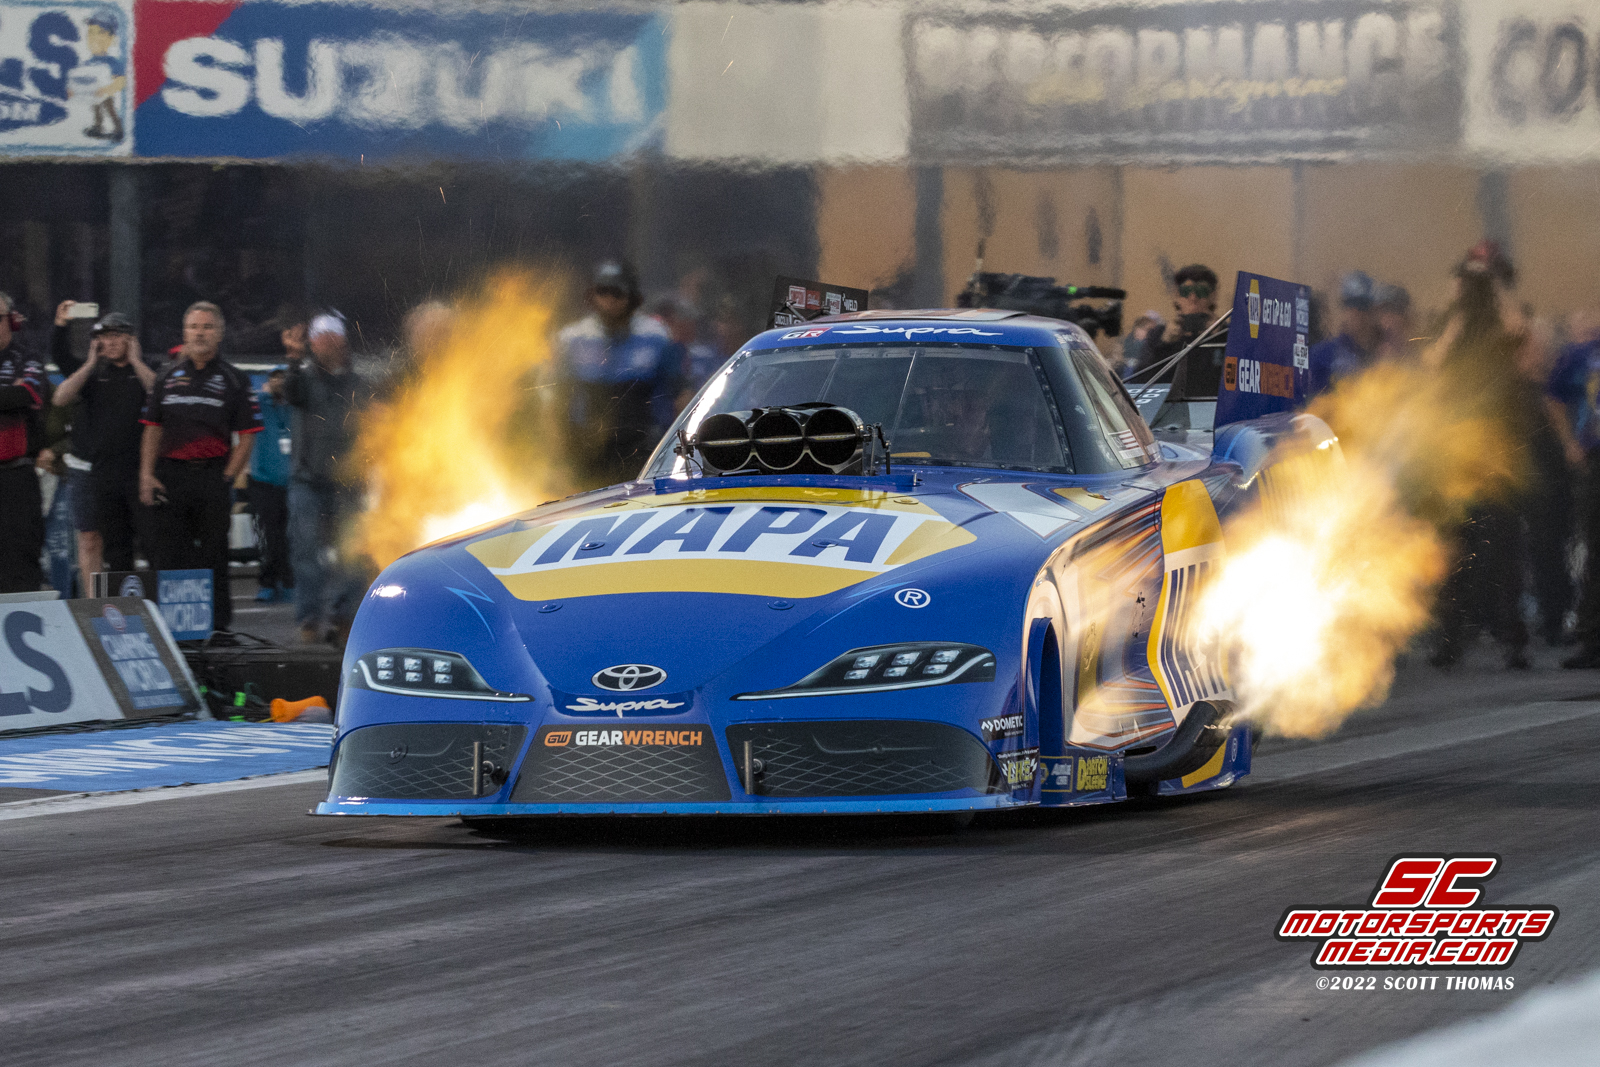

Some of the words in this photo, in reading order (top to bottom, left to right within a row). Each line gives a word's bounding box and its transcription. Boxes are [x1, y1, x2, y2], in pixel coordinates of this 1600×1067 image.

[1262, 298, 1273, 324] GET
[784, 327, 827, 340] GR
[832, 325, 1004, 340] Supra
[532, 506, 899, 566] NAPA
[565, 698, 685, 718] Supra
[994, 715, 1023, 731] DOMETIC
[575, 731, 703, 746] GEARWRENCH
